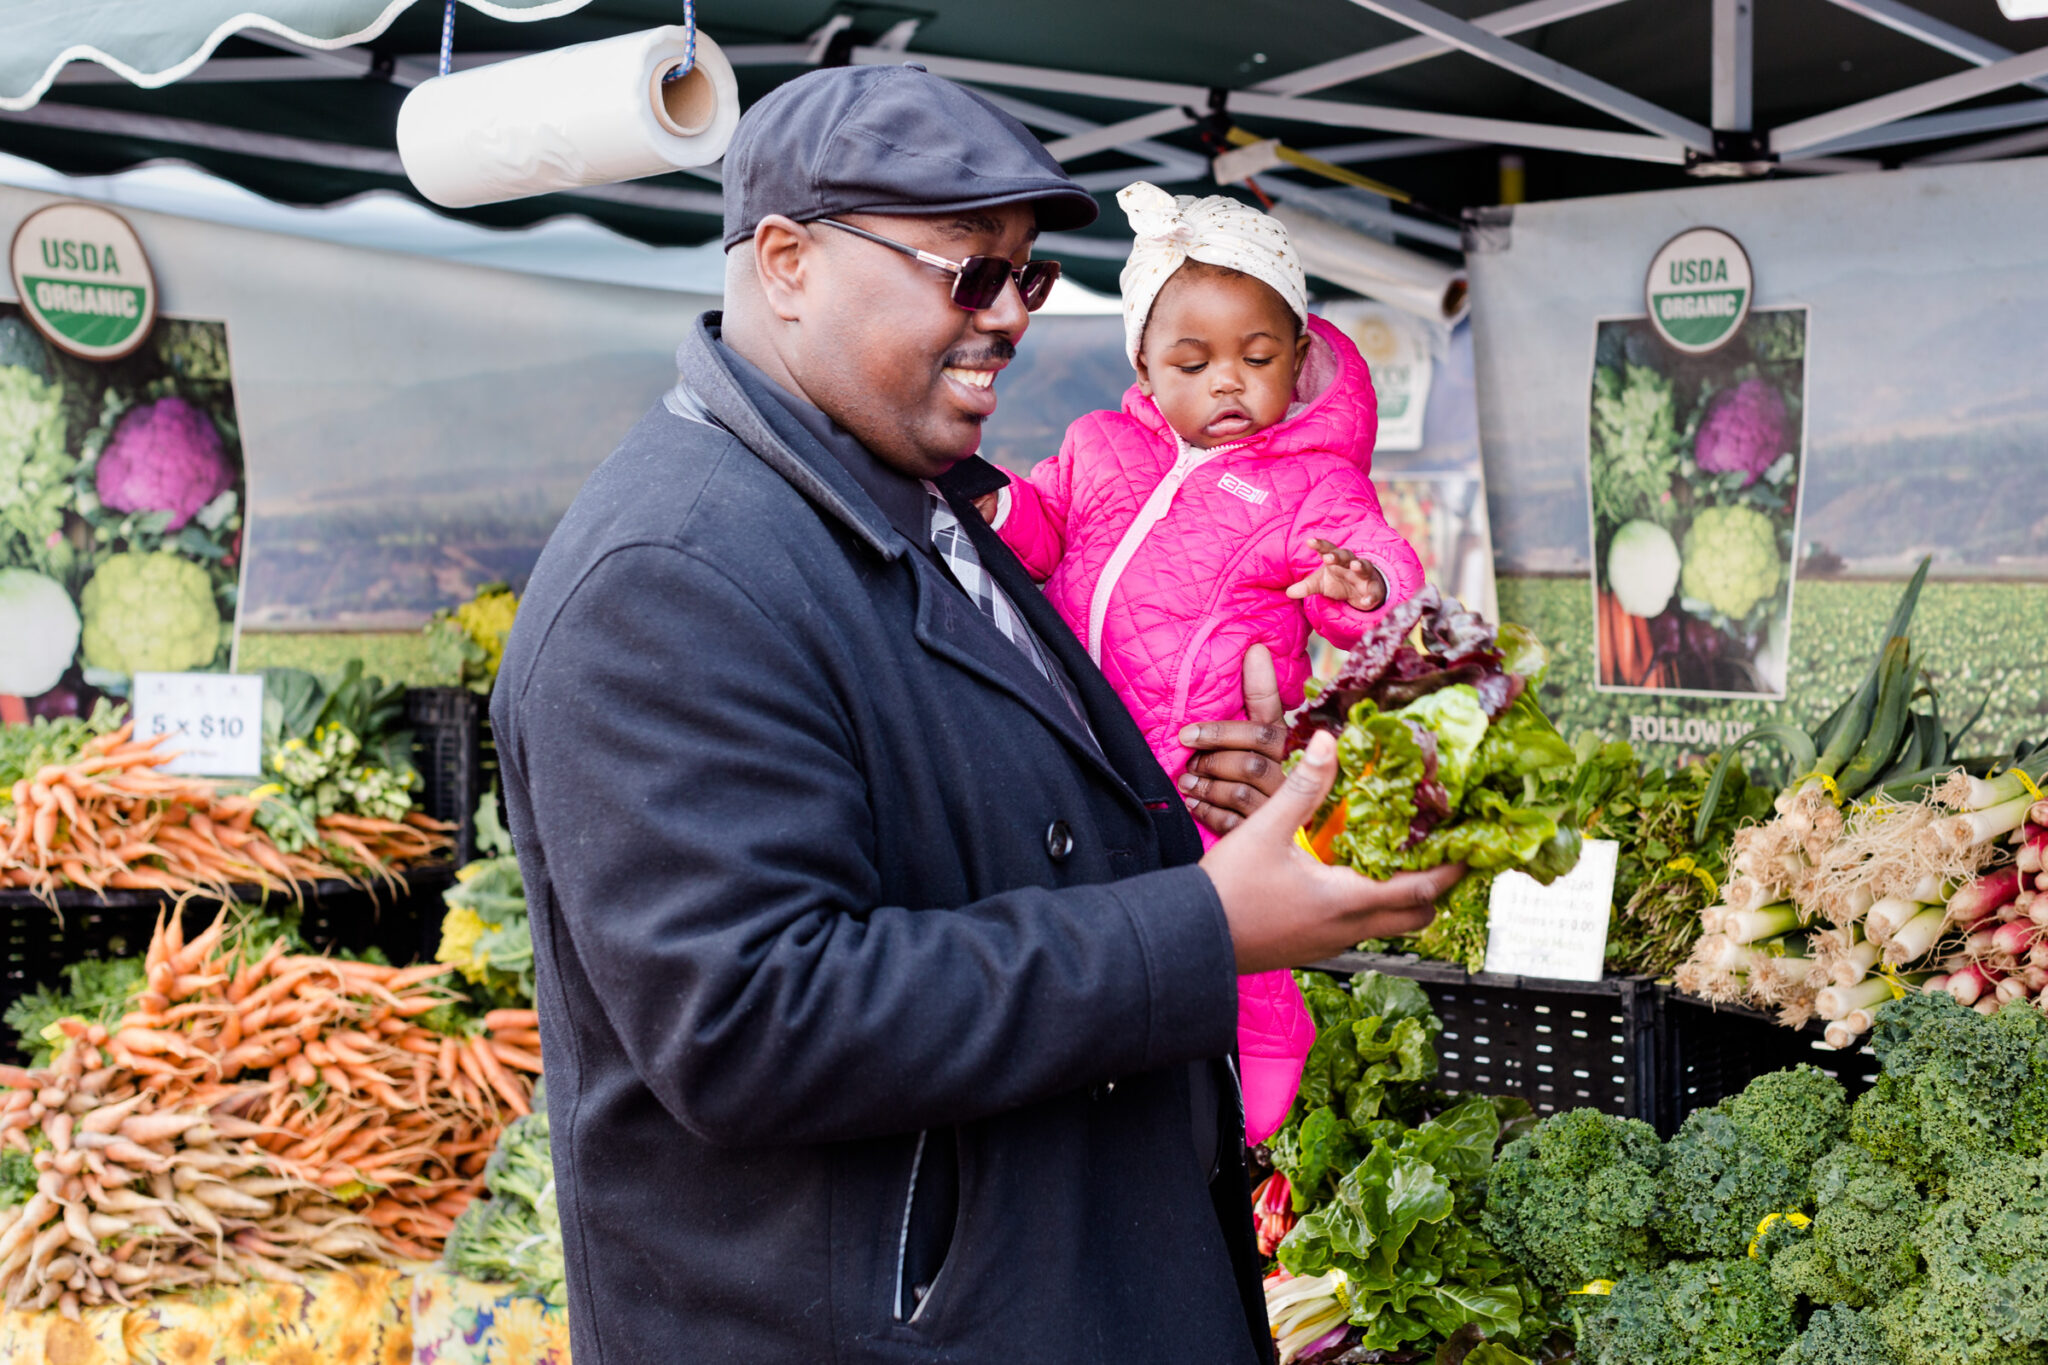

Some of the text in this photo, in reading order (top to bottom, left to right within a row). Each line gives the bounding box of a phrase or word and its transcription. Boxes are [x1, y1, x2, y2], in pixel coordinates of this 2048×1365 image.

[40, 237, 121, 276] USDA
[1670, 256, 1728, 286] USDA
[35, 280, 139, 320] ORGANIC
[1660, 292, 1738, 321] ORGANIC
[152, 713, 245, 740] 5 x $10
[1629, 714, 1722, 745] FOLLOW
